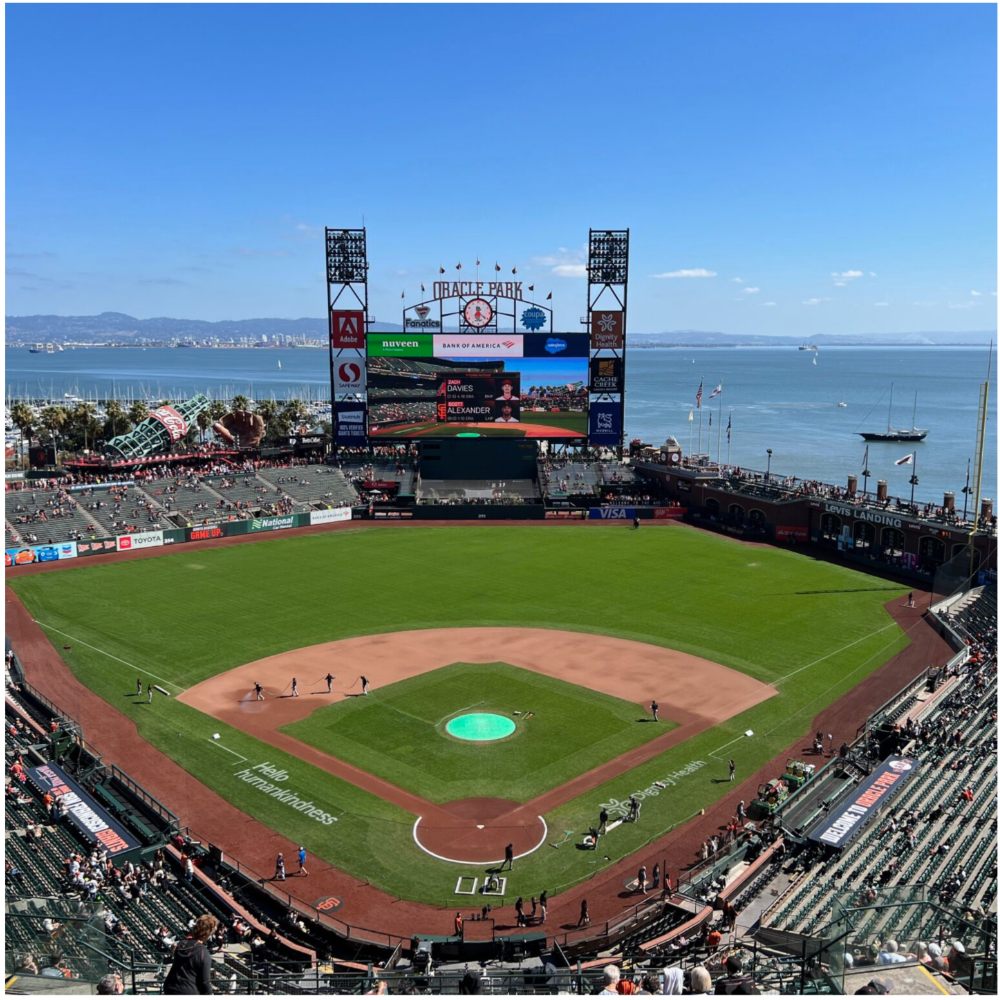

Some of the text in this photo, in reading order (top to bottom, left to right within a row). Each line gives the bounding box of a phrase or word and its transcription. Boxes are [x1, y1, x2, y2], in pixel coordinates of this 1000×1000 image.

[433, 281, 523, 300] ORACLE PARK
[523, 310, 545, 319] coupa
[405, 318, 440, 329] Fanatics
[595, 334, 618, 342] Dignity
[382, 340, 419, 348] nuveen
[447, 384, 474, 392] DAVIES
[600, 508, 627, 519] VISA
[853, 510, 902, 528] LANDING
[262, 516, 294, 527] National
[134, 536, 161, 544] TOYOTA
[191, 530, 210, 540] GAME
[252, 761, 289, 782] Hello
[671, 759, 708, 780] Health
[234, 768, 338, 826] humankindness
[819, 771, 901, 844] WELCOME TO ORACLE PARK
